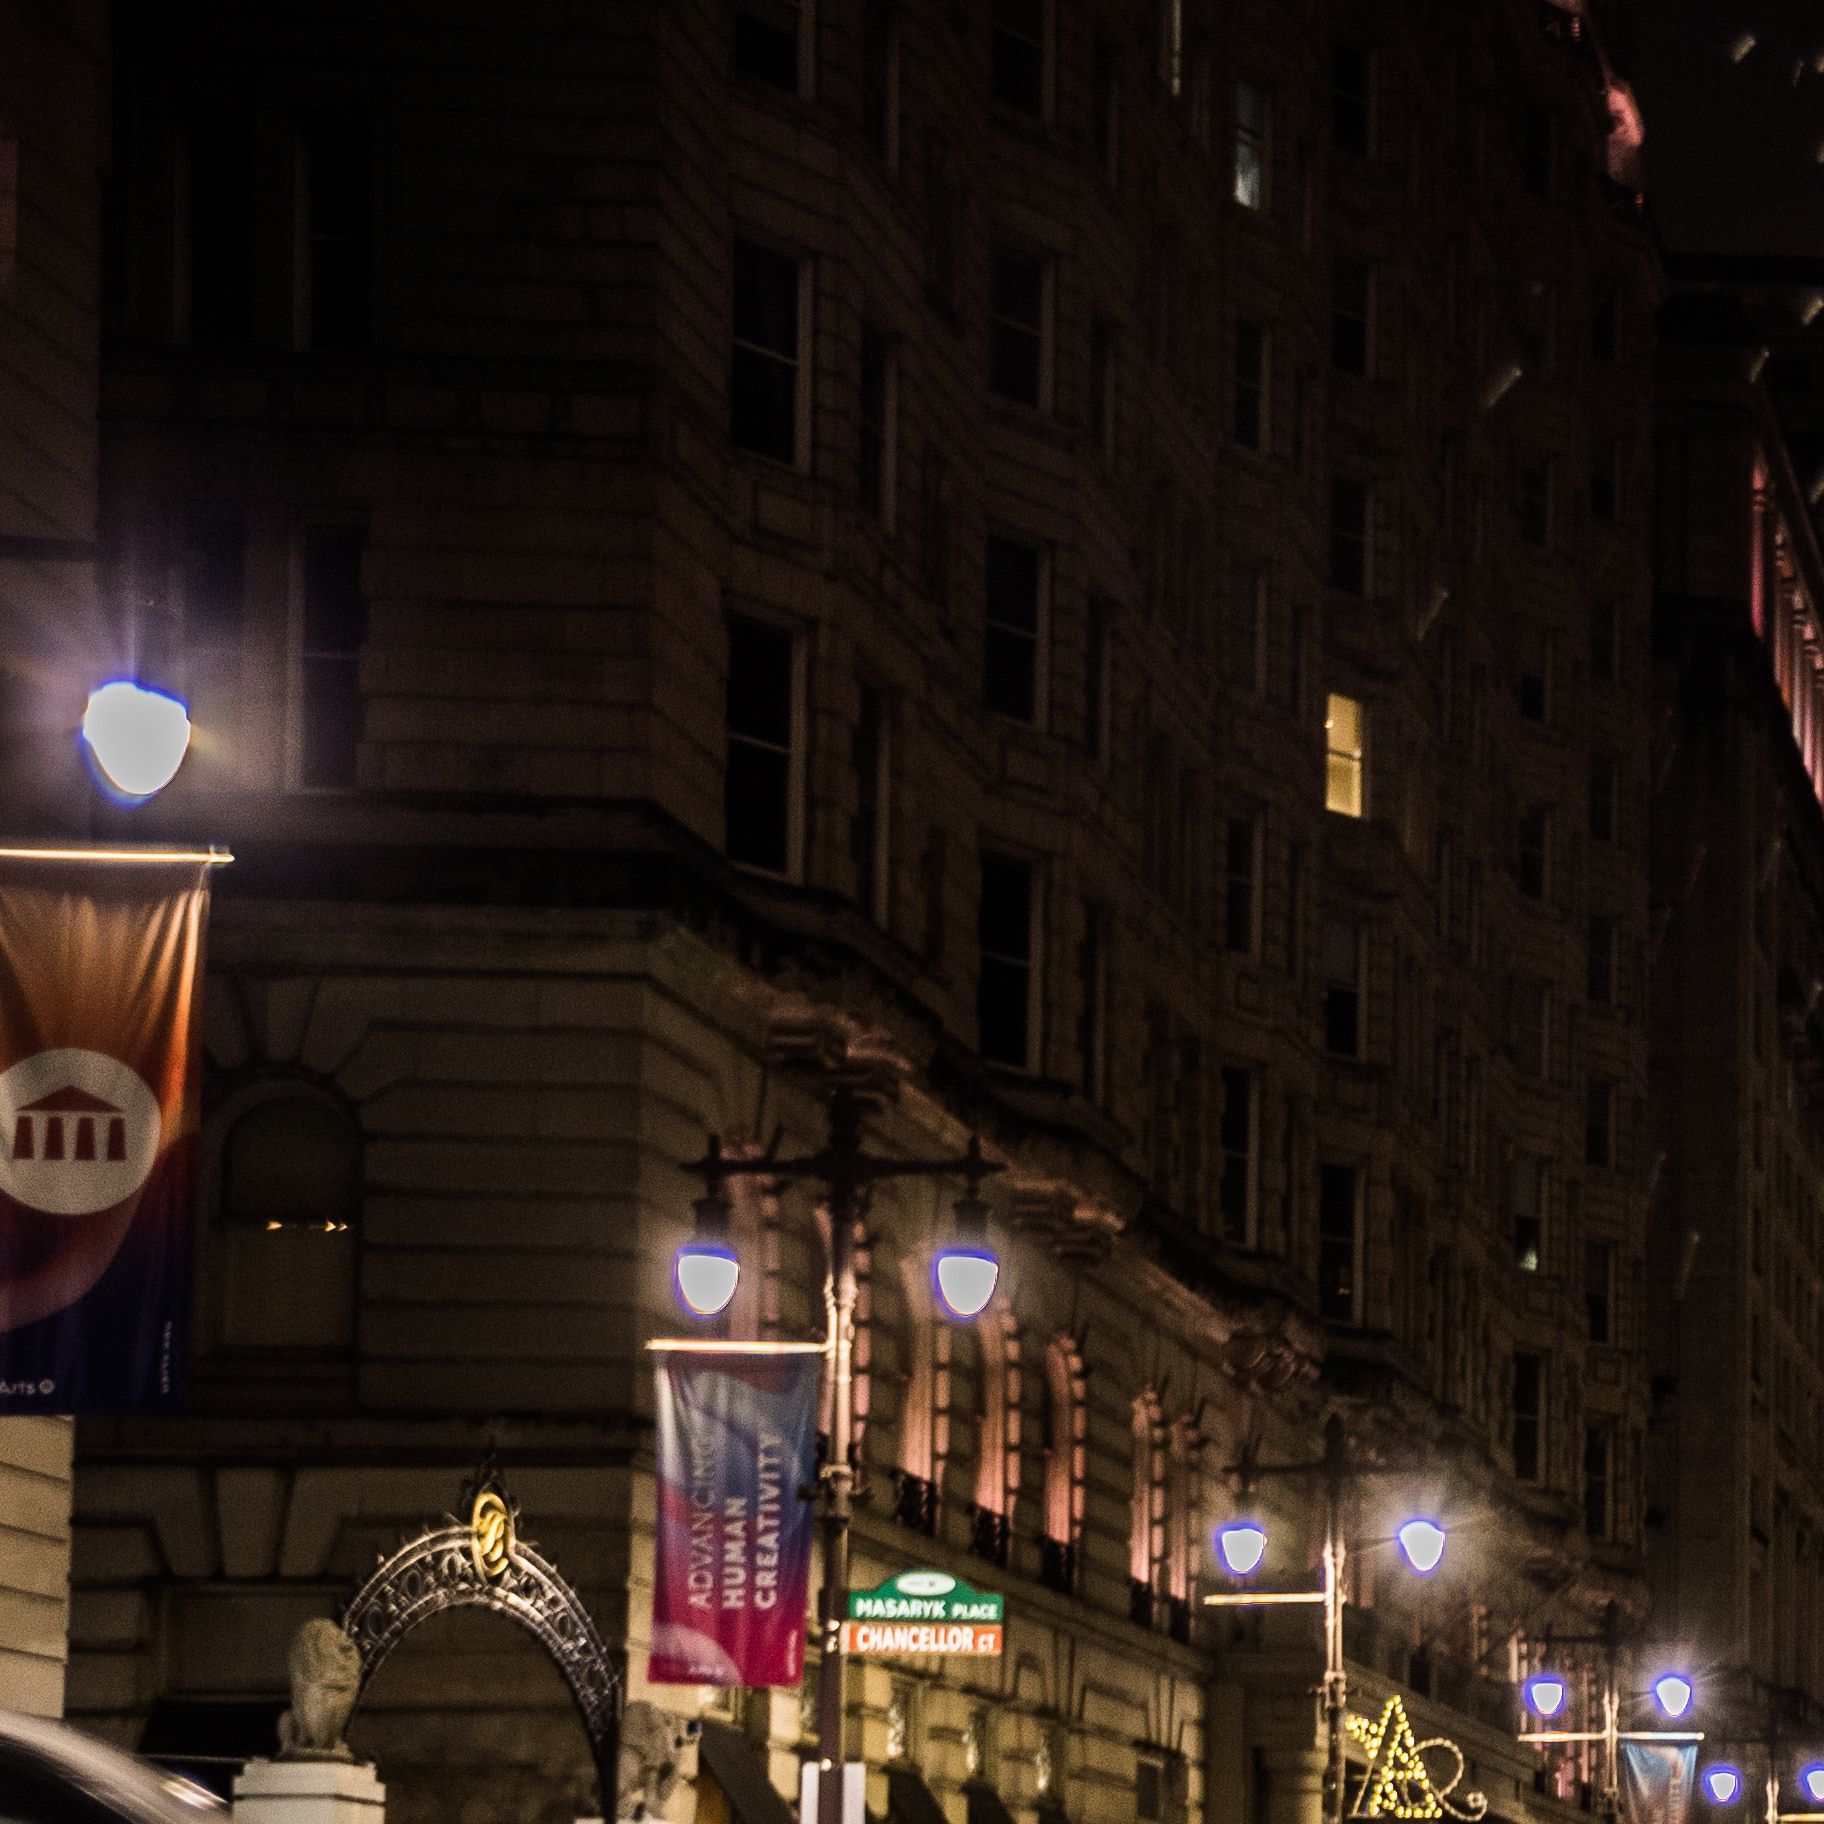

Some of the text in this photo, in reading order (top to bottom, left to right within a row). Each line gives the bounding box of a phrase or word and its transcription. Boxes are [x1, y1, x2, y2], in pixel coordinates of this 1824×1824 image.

[722, 1497, 747, 1610] HUMAN
[754, 1431, 782, 1611] CREATIVITY
[855, 1598, 998, 1619] MASARYK PLACE
[857, 1626, 996, 1652] CHANCELLOR CT
